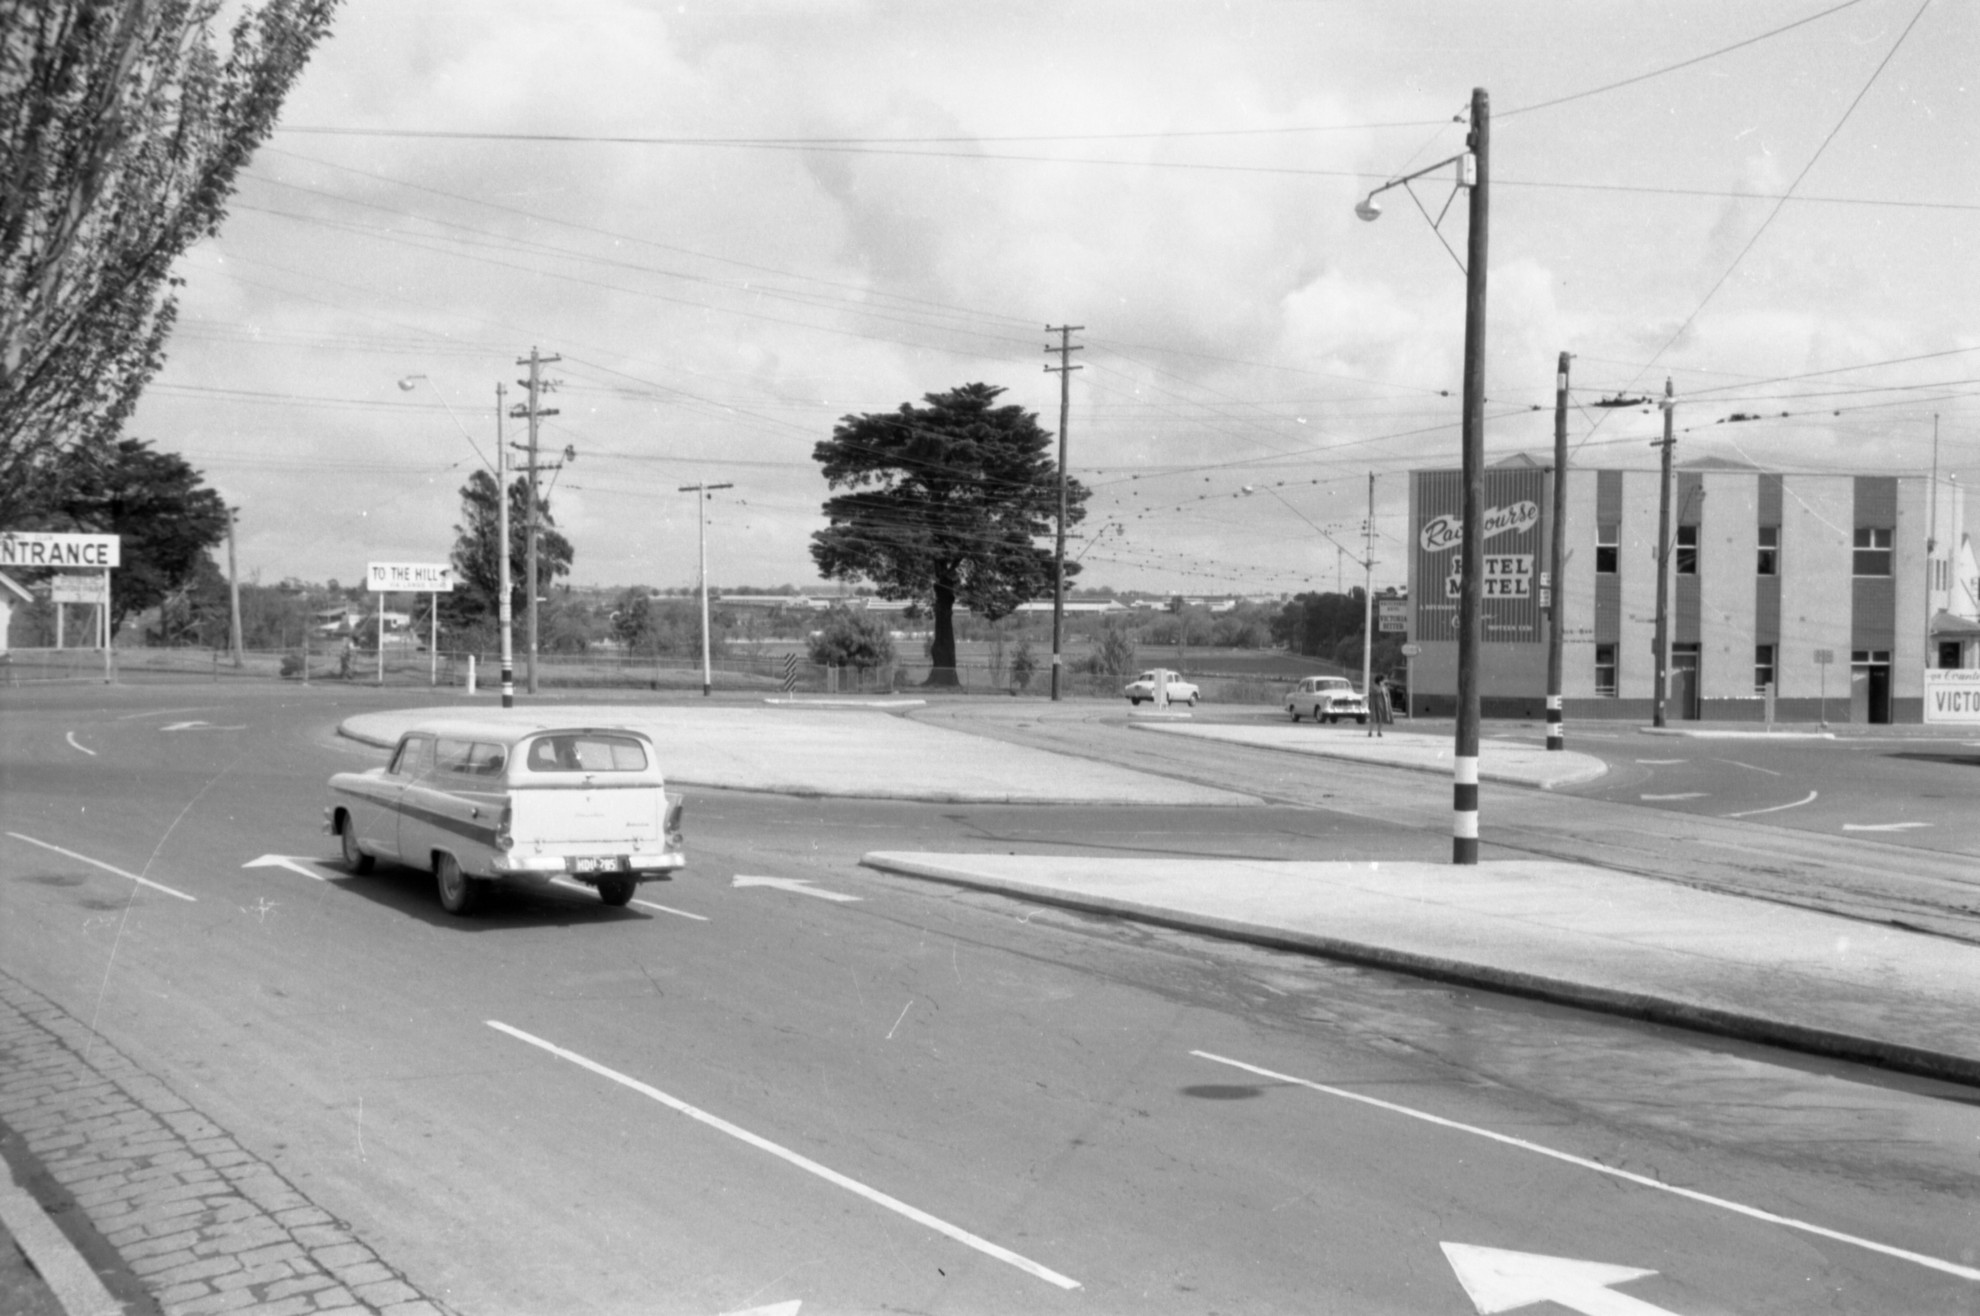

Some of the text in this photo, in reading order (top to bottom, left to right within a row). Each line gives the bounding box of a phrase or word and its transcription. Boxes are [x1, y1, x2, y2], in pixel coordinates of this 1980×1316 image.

[1425, 503, 1537, 548] Racourse
[372, 566, 438, 582] TO THE HILL
[1454, 558, 1529, 575] HTEL
[1449, 578, 1528, 595] MTEL
